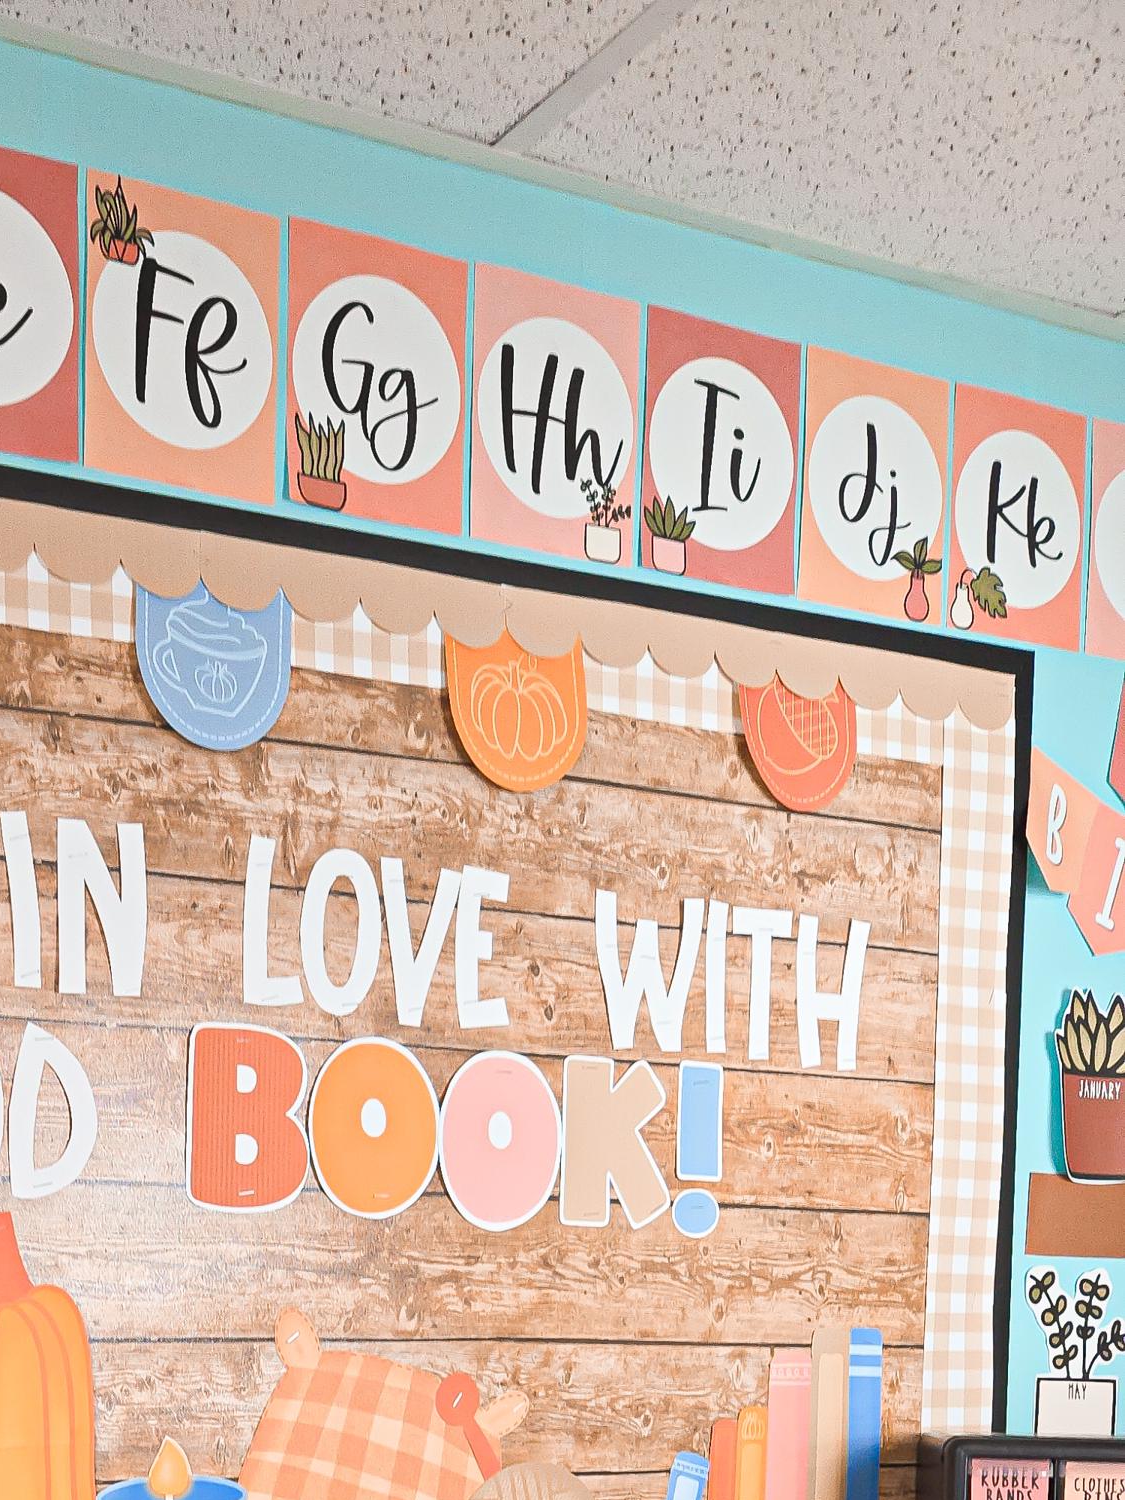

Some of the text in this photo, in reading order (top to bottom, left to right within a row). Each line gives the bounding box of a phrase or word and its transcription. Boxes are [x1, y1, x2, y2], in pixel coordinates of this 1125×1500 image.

[135, 258, 247, 428] Ff
[321, 301, 438, 471] Gg
[501, 343, 623, 494] Hh
[692, 378, 760, 511] Ii
[986, 461, 1062, 567] Kk
[0, 810, 147, 997] IN
[242, 834, 509, 1029] LOVE
[594, 889, 870, 1071] WITH
[186, 1022, 723, 1238] BOOK!
[1078, 1079, 1121, 1100] JANUARY
[1068, 1382, 1087, 1400] MAY
[981, 1466, 1039, 1490] RUBBER
